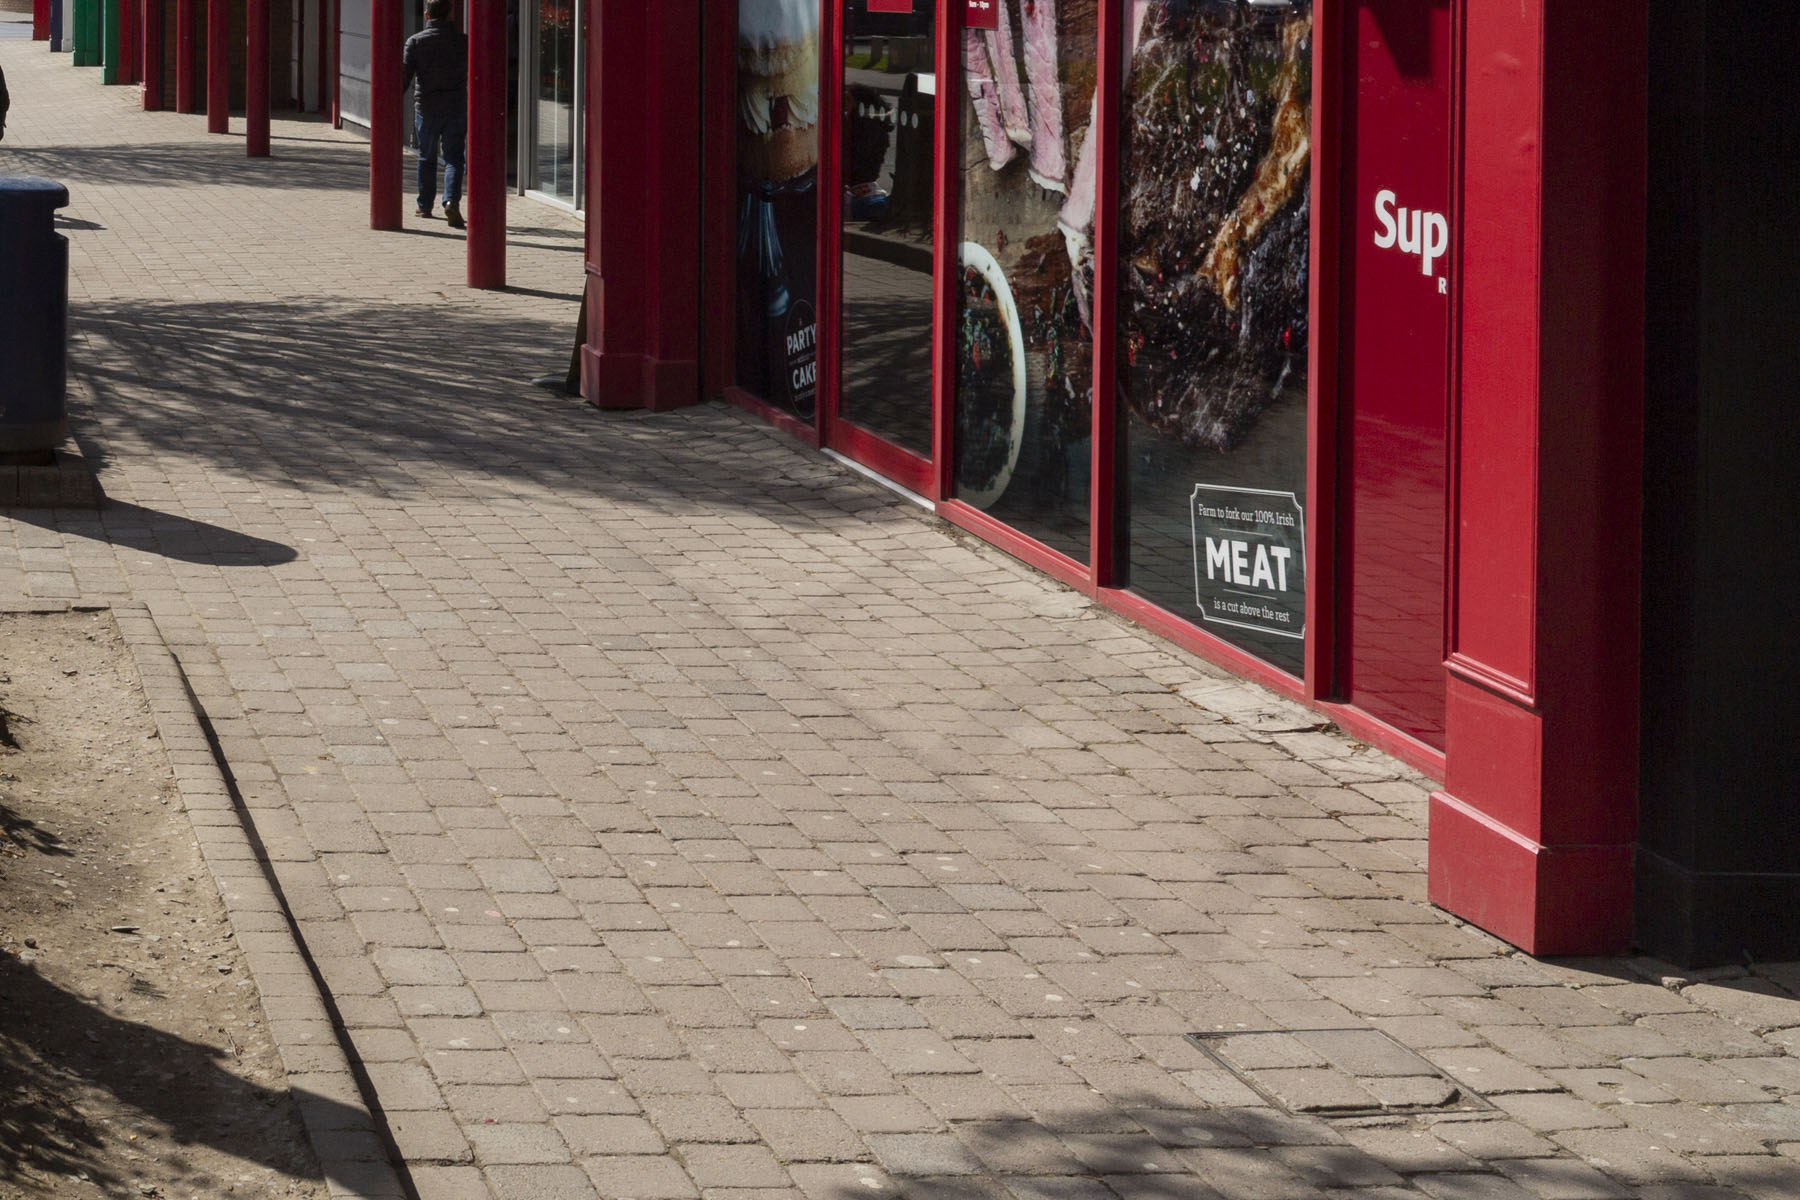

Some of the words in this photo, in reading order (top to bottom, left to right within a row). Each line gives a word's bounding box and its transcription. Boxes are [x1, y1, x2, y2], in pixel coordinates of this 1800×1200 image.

[1374, 189, 1449, 276] Sup
[786, 322, 817, 356] PARTY
[1198, 503, 1216, 517] Farm
[1217, 507, 1224, 519] to
[1225, 506, 1240, 520] fork
[1241, 511, 1253, 522] our
[1255, 509, 1274, 524] 100%
[1276, 512, 1295, 527] Irish
[1206, 537, 1291, 592] MEAT
[1213, 596, 1220, 610] is
[1222, 601, 1226, 610] a
[1227, 602, 1239, 614] cut
[1240, 601, 1261, 617] above
[1262, 605, 1274, 620] the
[1275, 611, 1290, 623] rest
